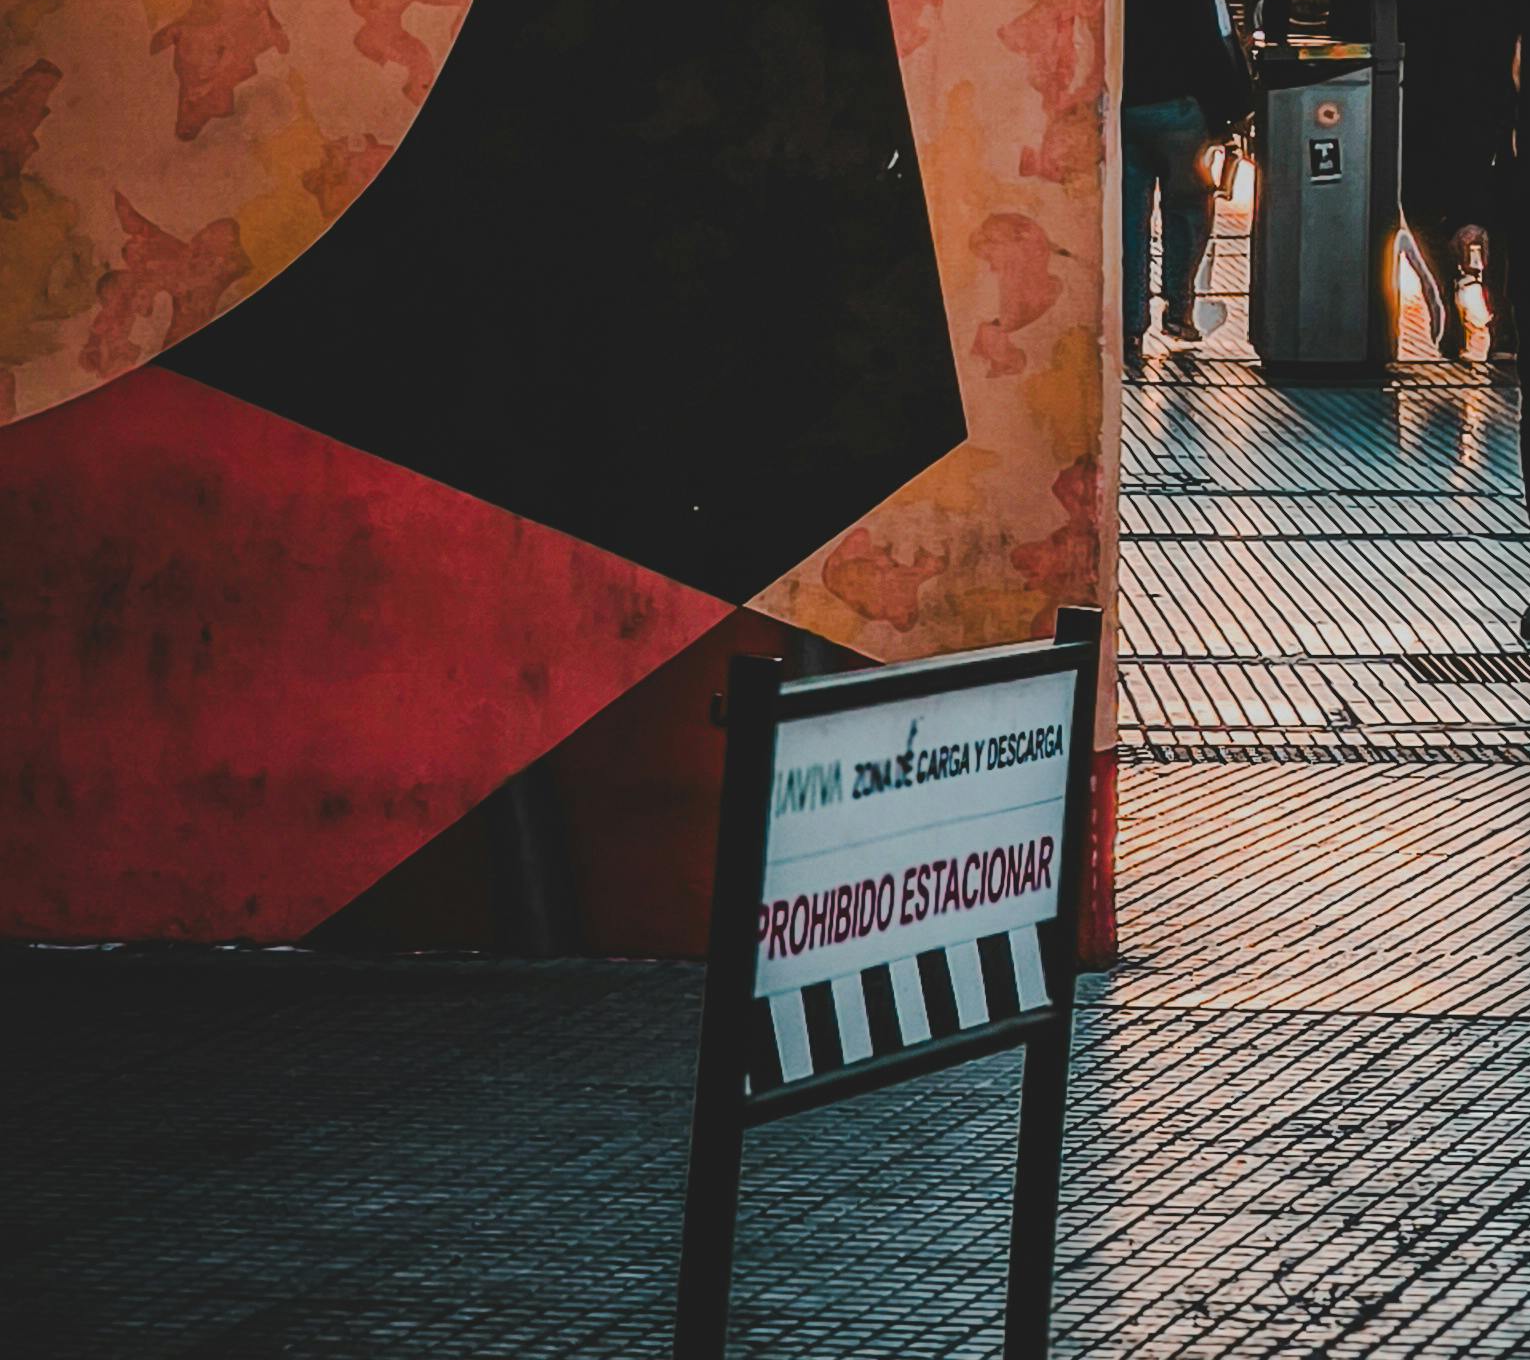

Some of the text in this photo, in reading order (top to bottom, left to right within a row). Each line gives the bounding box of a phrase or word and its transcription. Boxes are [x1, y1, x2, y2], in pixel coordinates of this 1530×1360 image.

[916, 741, 970, 784] CARGA
[974, 739, 985, 773] Y
[987, 724, 1064, 771] DESCARGA
[756, 836, 1054, 960] PROHIBIDO ESTACIONAR
